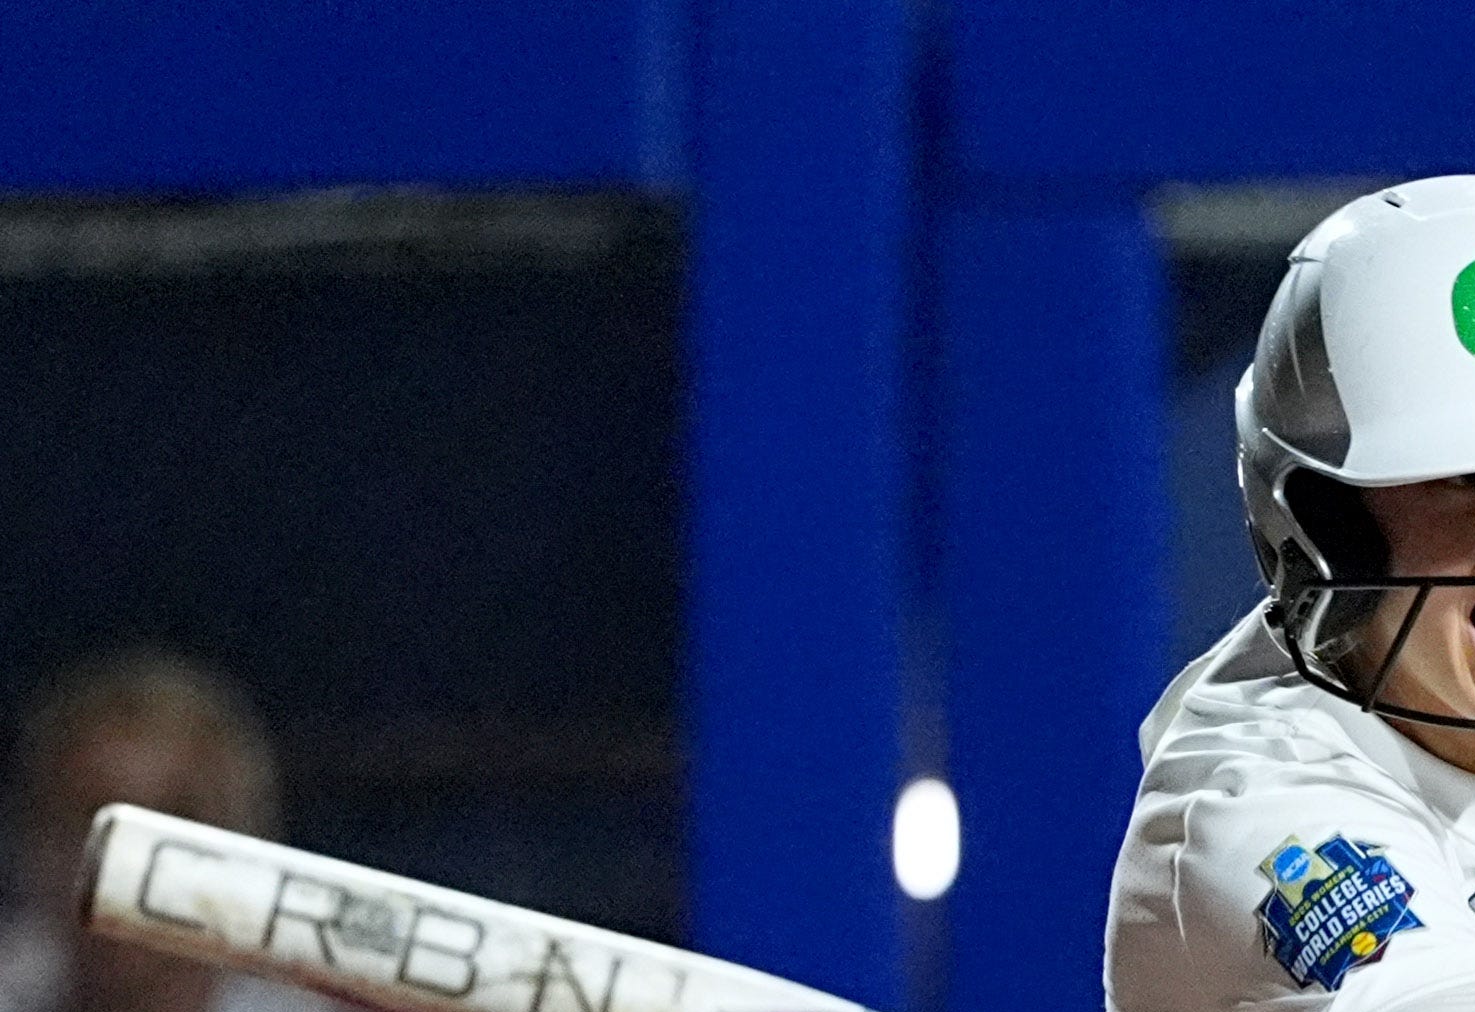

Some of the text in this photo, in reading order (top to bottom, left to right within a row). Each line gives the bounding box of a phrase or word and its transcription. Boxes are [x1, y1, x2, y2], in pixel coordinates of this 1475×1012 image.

[1280, 853, 1311, 881] NCAA
[1291, 874, 1406, 981] WORLD SERIES
[1295, 871, 1368, 942] COLLEGE
[1320, 903, 1389, 966] OKLAHOMA CITY
